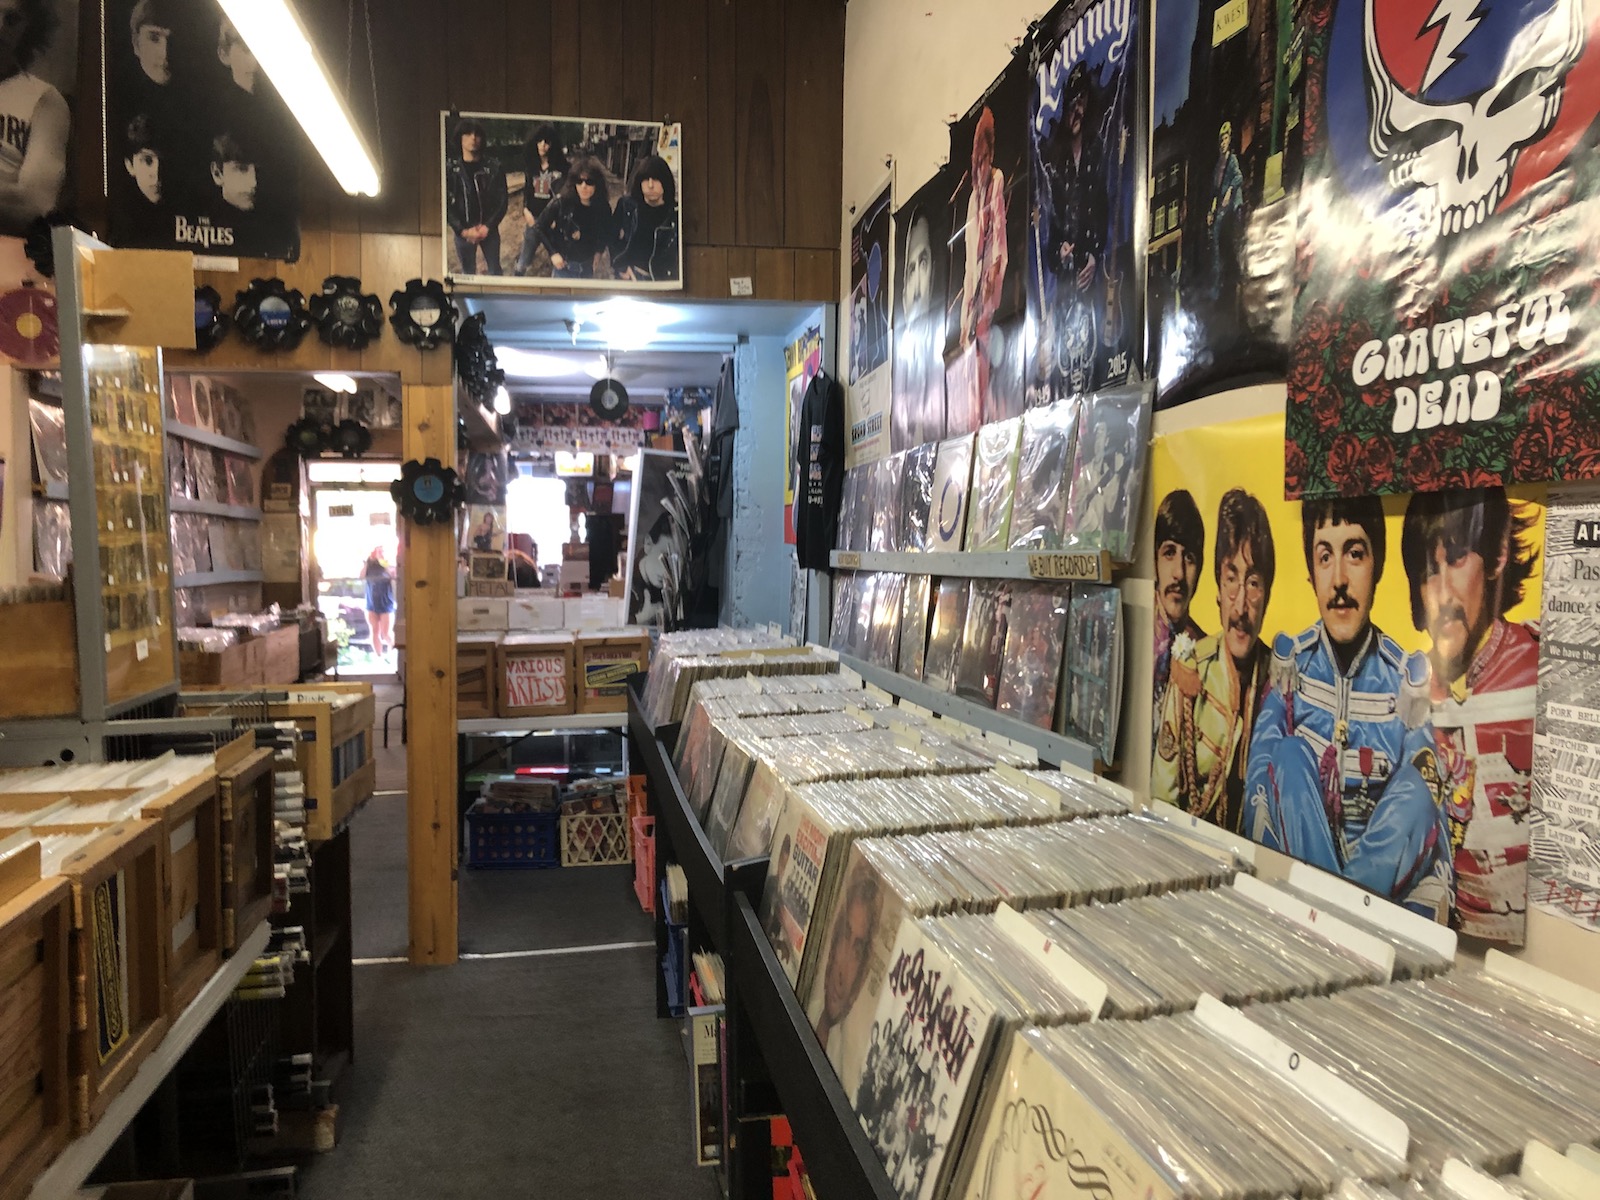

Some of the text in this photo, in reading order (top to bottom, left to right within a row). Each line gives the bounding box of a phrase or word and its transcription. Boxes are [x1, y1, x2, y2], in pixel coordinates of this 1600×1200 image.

[1224, 2, 1246, 24] WEST
[198, 216, 210, 225] THE
[175, 215, 235, 248] BEATLES
[1352, 292, 1571, 386] GRATEFUL
[1107, 351, 1127, 378] 2015
[1391, 370, 1502, 434] DEAD
[1053, 554, 1096, 577] RECORDS
[1573, 559, 1600, 581] Pas
[1549, 645, 1597, 661] We have the
[507, 658, 563, 673] VARIOUS
[1550, 705, 1572, 718] PORK
[1548, 736, 1589, 753] BUTCHER
[1556, 773, 1584, 788] BLOOD
[1546, 799, 1593, 818] XXX SMUT
[792, 843, 819, 886] GUITAR
[1571, 870, 1590, 881] and
[1308, 908, 1318, 923] N
